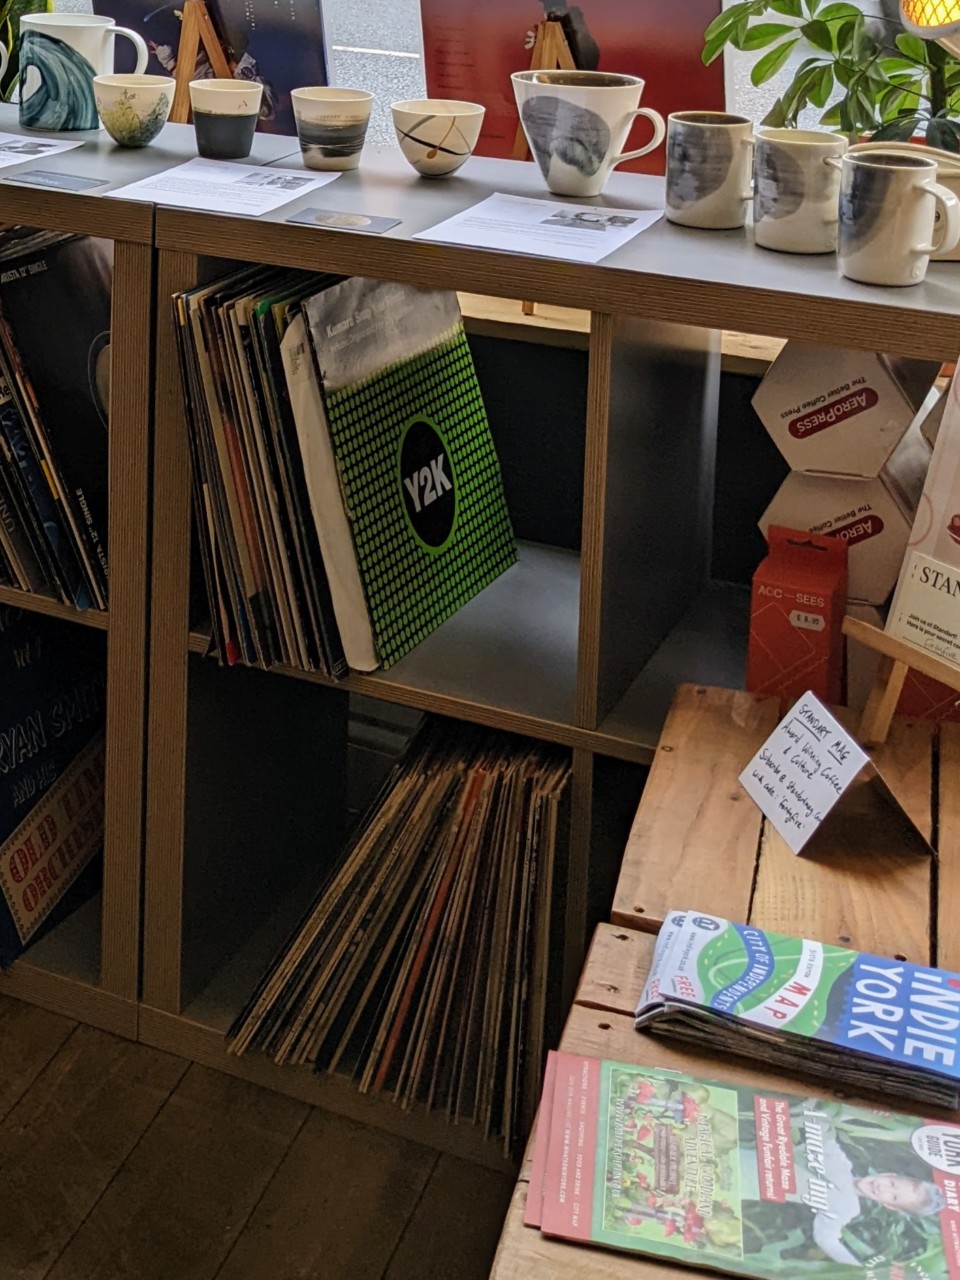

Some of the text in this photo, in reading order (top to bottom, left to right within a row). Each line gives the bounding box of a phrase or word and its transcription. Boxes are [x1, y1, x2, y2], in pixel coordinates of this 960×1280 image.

[780, 376, 867, 419] The Better Coffee Press
[404, 454, 452, 513] Y2K
[834, 510, 857, 523] Better
[857, 503, 873, 514] The
[758, 585, 825, 607] ACC SEES
[908, 613, 919, 622] Join
[906, 620, 918, 630] Here
[924, 629, 936, 638] your
[936, 634, 953, 646] secret
[797, 704, 850, 762] STANDART MAG
[820, 767, 843, 795] Coffee
[714, 930, 769, 1011] CITY OF INDEPENDENTS
[674, 975, 695, 998] FREE
[764, 981, 812, 1020] MAP
[847, 963, 905, 1051] YORK
[760, 1098, 768, 1112] and
[759, 1113, 772, 1143] Vintage
[762, 1143, 775, 1172] Funfair
[775, 1101, 791, 1190] The Great Ryedale Maze
[926, 1135, 942, 1159] GUIDE
[943, 1179, 960, 1212] DIARY
